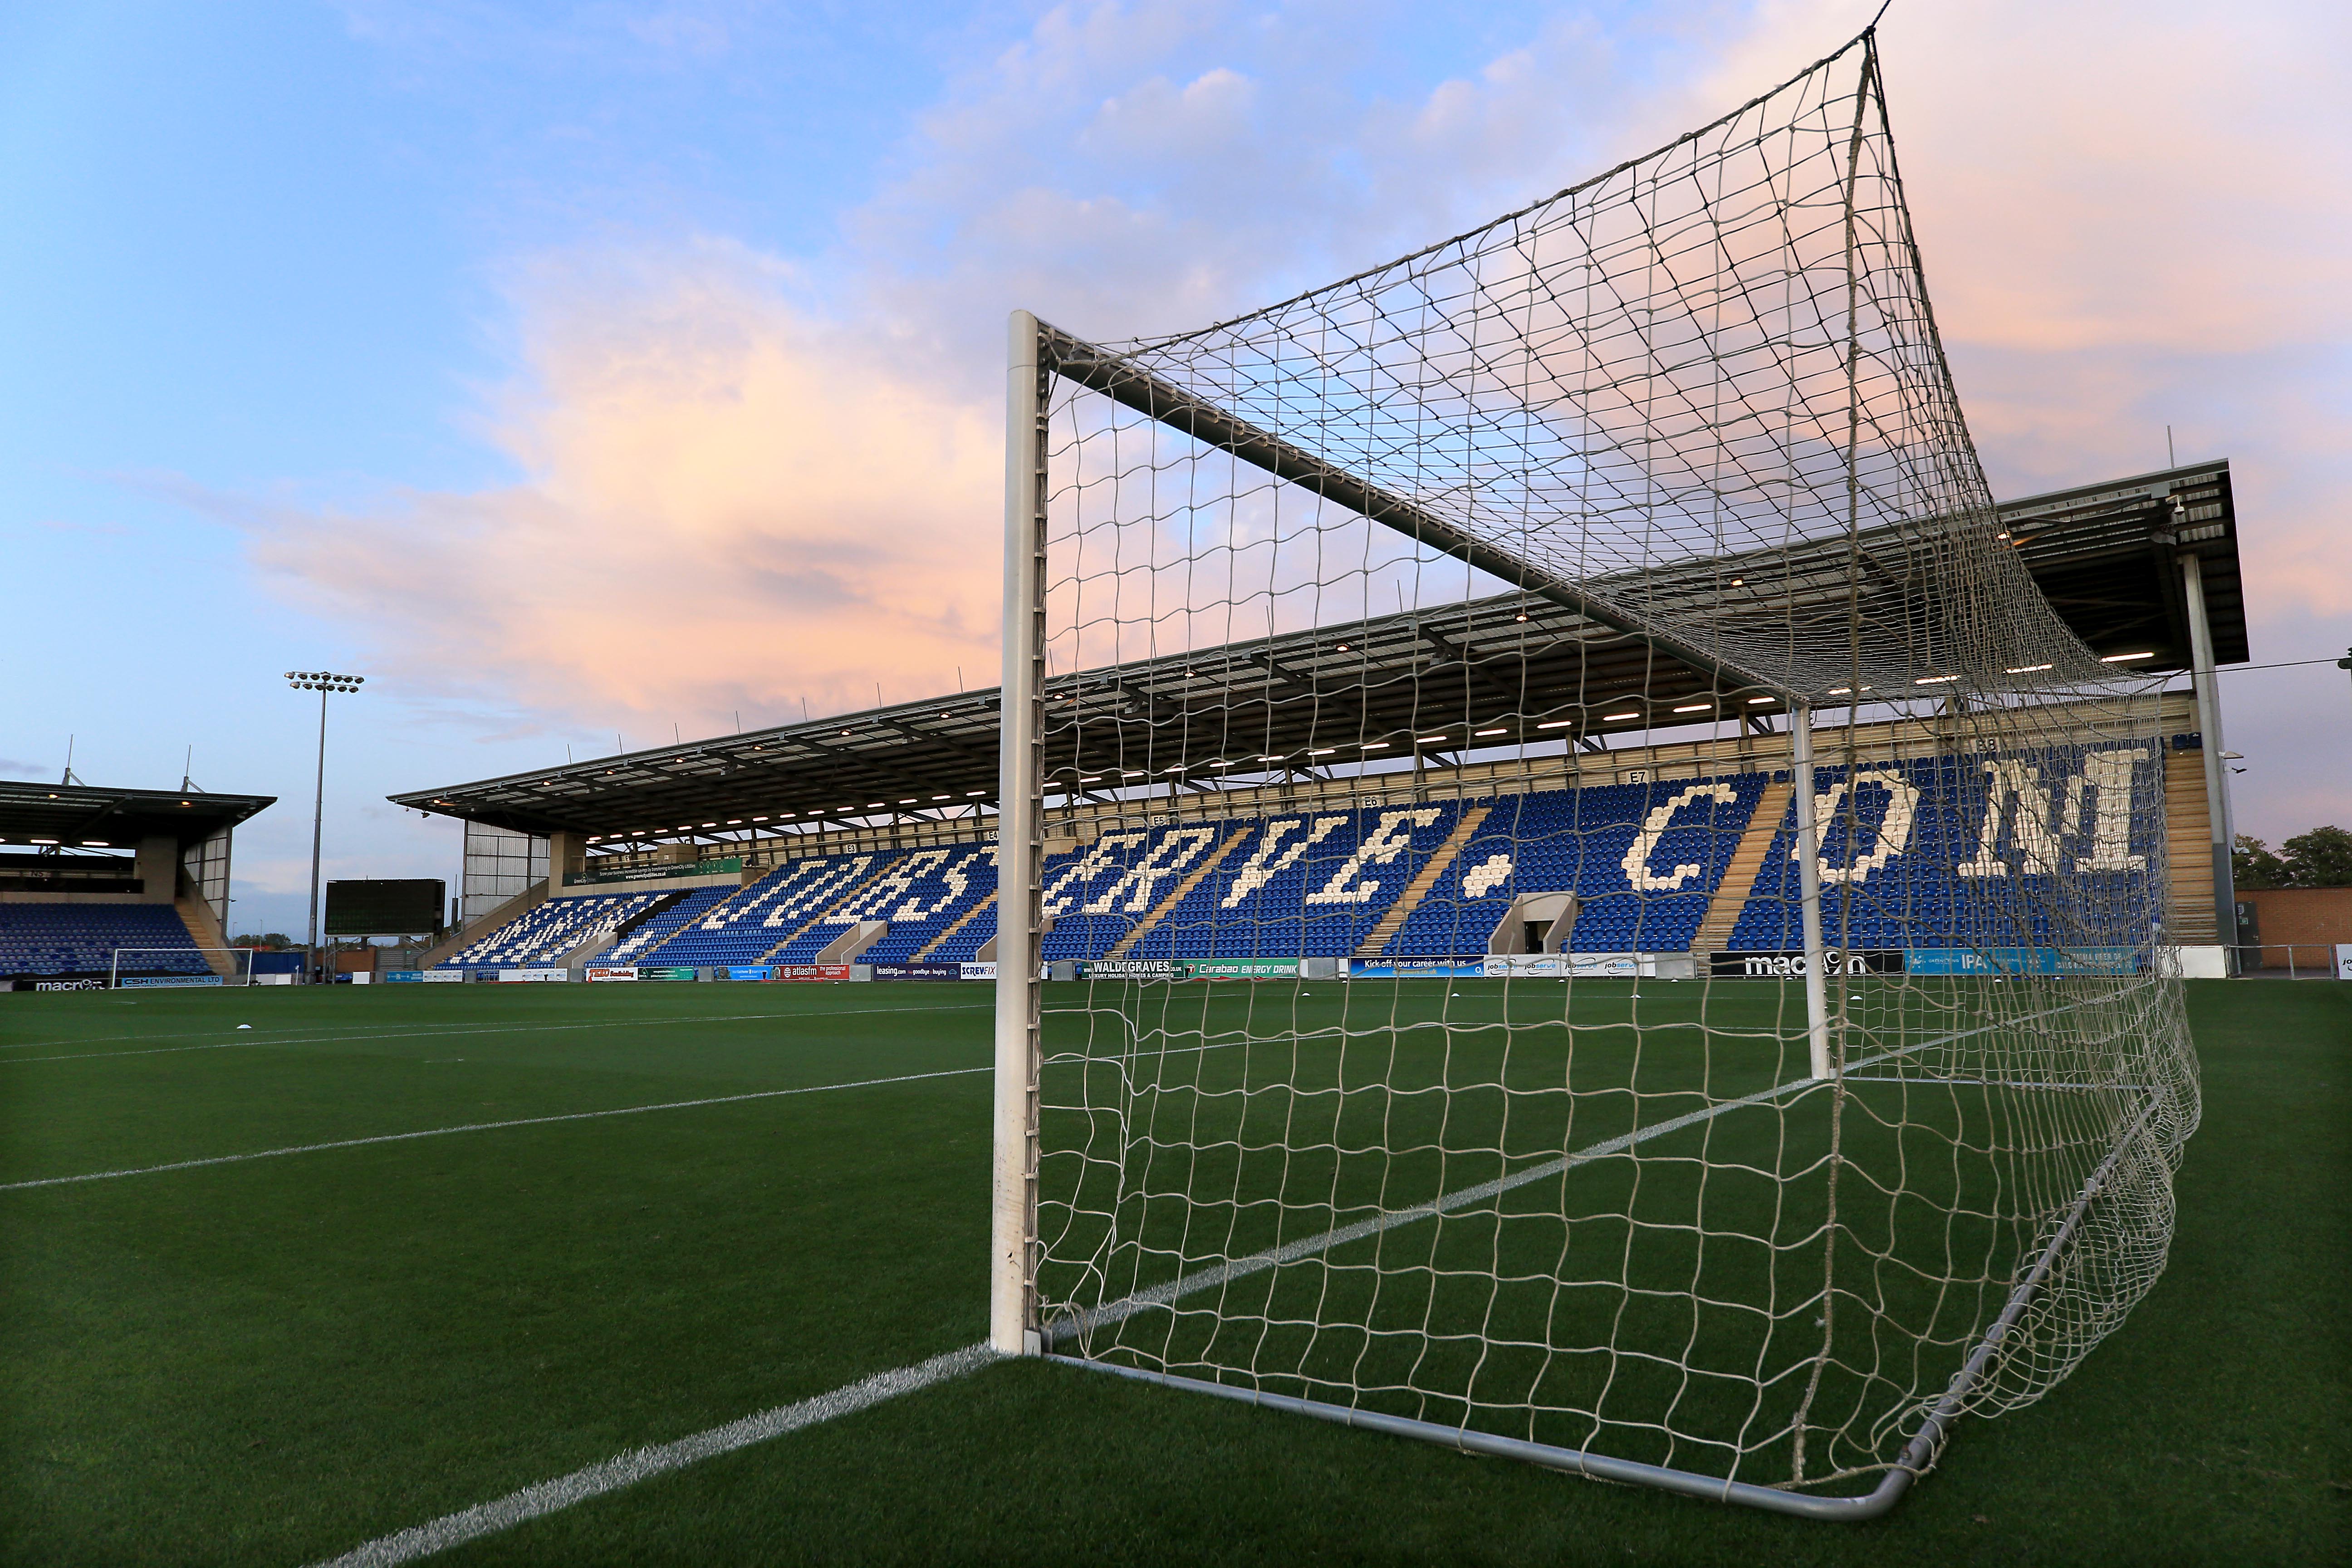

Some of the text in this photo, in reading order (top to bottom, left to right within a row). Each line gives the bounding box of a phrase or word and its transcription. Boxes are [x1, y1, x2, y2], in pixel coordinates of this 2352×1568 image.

[1630, 771, 1646, 783] E7
[1364, 796, 1377, 806] E6
[1153, 816, 1164, 825] E5
[989, 831, 998, 839] E4
[1381, 959, 1392, 967] off
[1393, 961, 1411, 970] your
[1437, 959, 1455, 967] with
[1745, 951, 1866, 975] macon
[1961, 954, 1987, 969] IPA
[589, 968, 610, 977] TEXO
[792, 966, 817, 975] atlasfm
[877, 966, 906, 977] leasing.com
[962, 966, 996, 976] SCREWFIX
[1199, 964, 1297, 974] Carabao ENERGY DRINK
